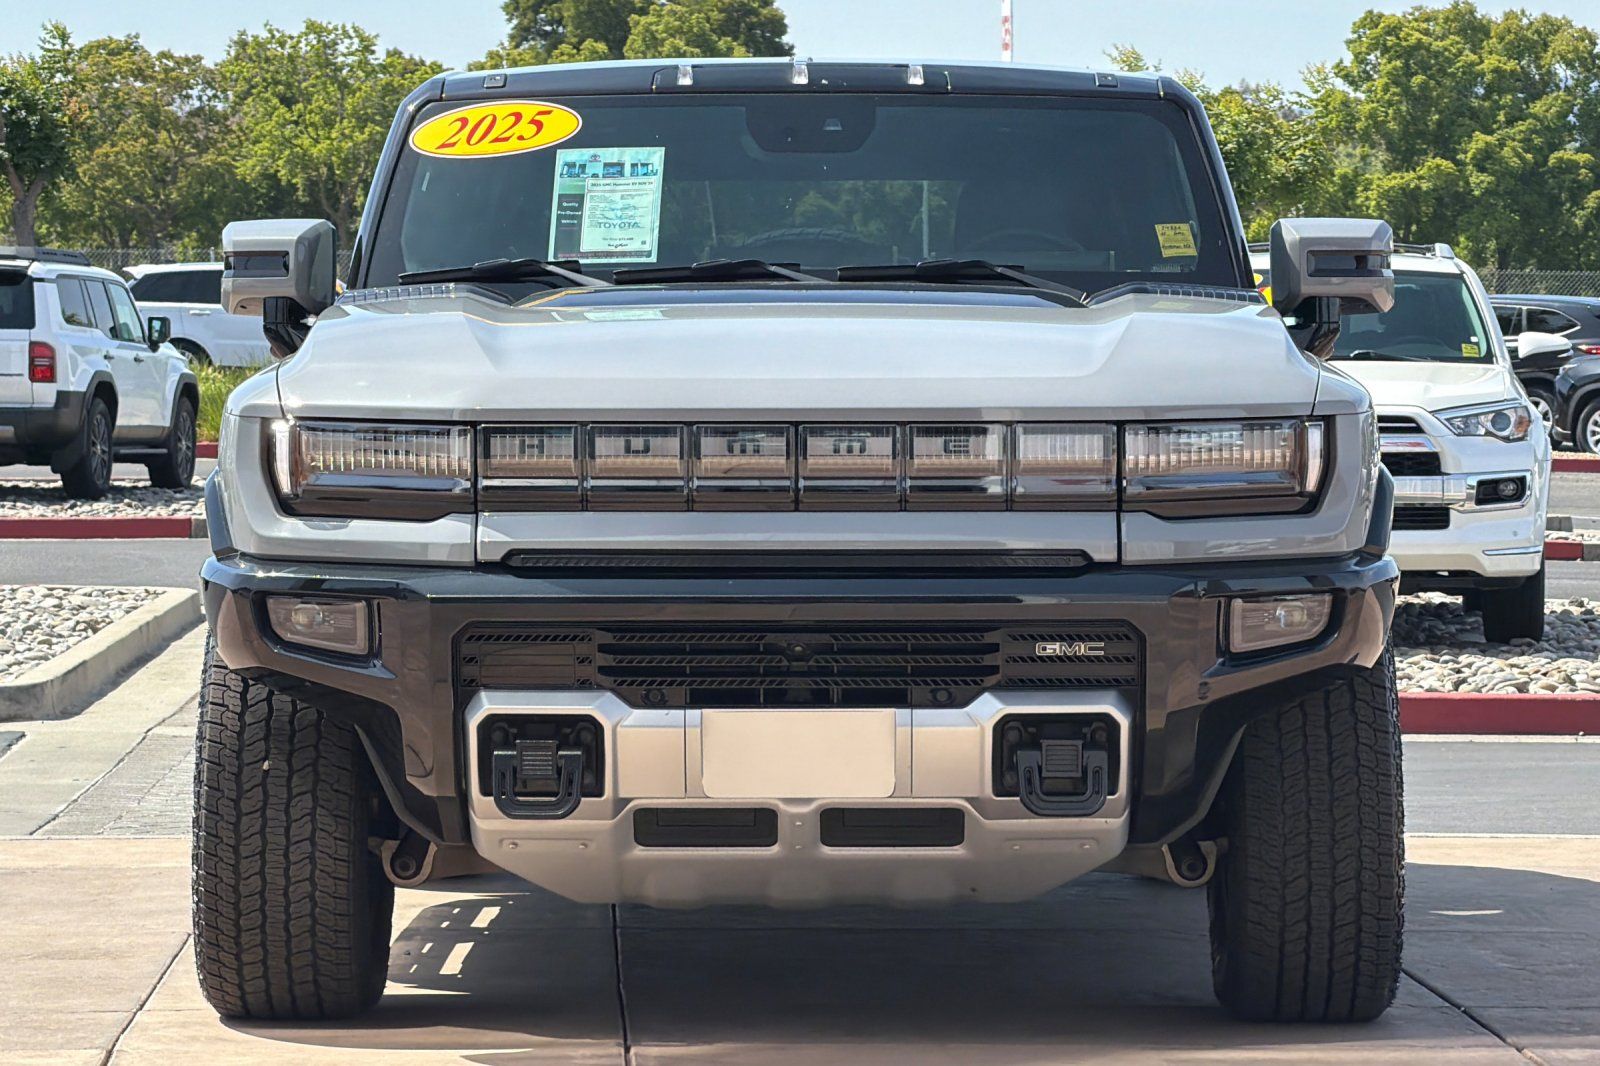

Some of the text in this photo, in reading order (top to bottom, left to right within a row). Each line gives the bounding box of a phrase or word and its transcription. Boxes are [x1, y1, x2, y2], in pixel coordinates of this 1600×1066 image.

[435, 109, 553, 150] 2025
[596, 221, 641, 229] TOYOTA
[1035, 641, 1105, 656] GMC
